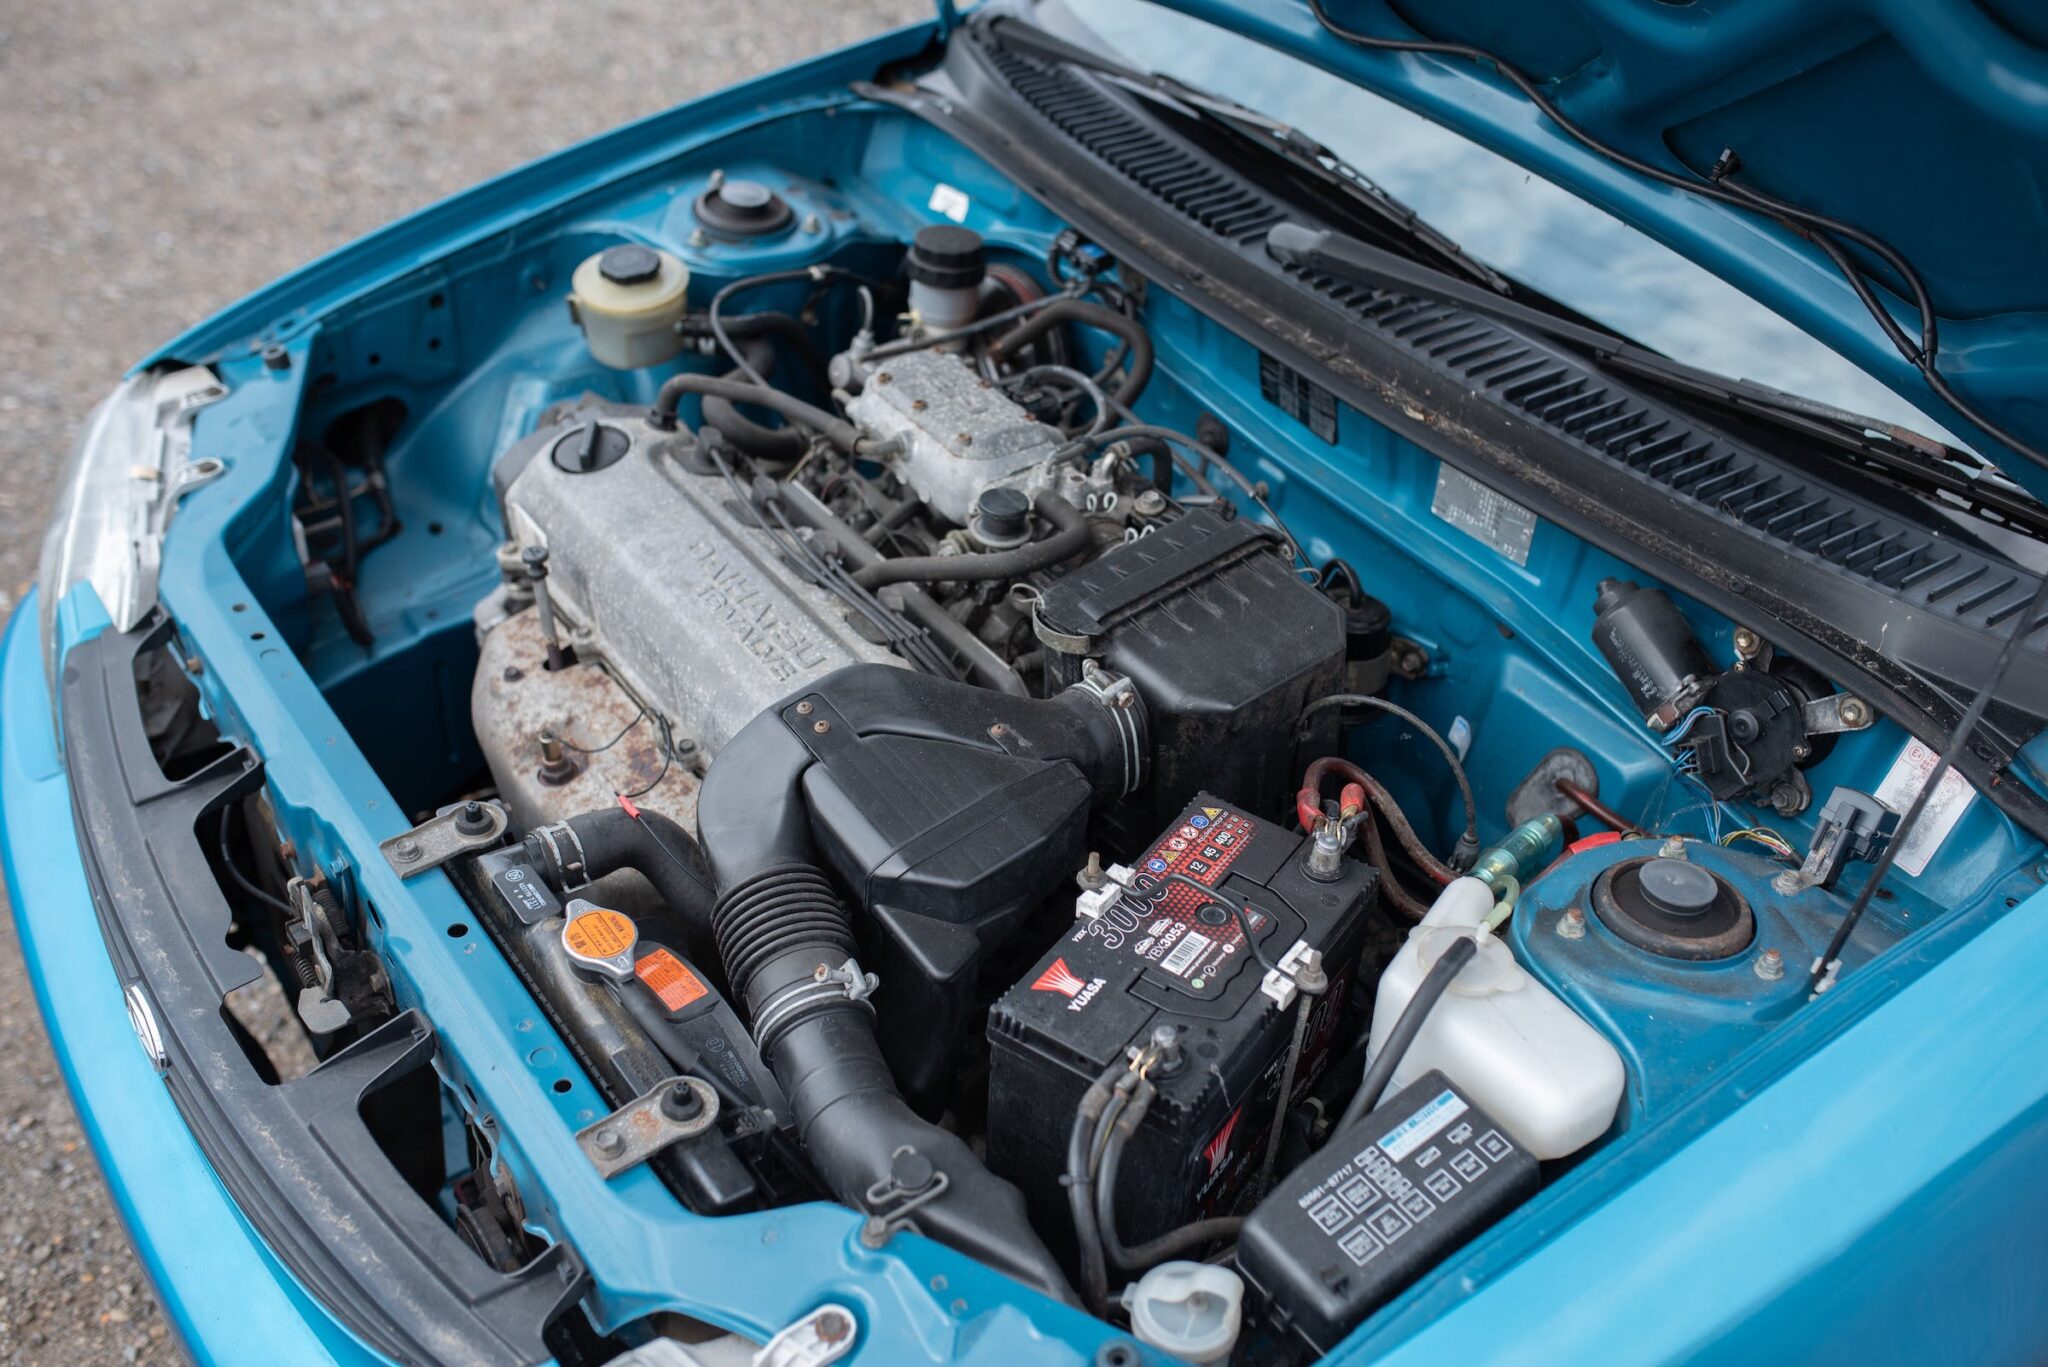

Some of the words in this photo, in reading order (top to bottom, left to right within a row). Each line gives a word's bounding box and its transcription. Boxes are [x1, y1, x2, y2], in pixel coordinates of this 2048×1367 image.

[689, 542, 827, 669] DAIHATSU
[726, 609, 798, 682] VALVE
[1204, 846, 1217, 857] 45
[1215, 831, 1231, 845] 400
[1190, 861, 1203, 871] 12
[1145, 922, 1187, 960] YBX3053
[1067, 978, 1107, 1011] YUASA
